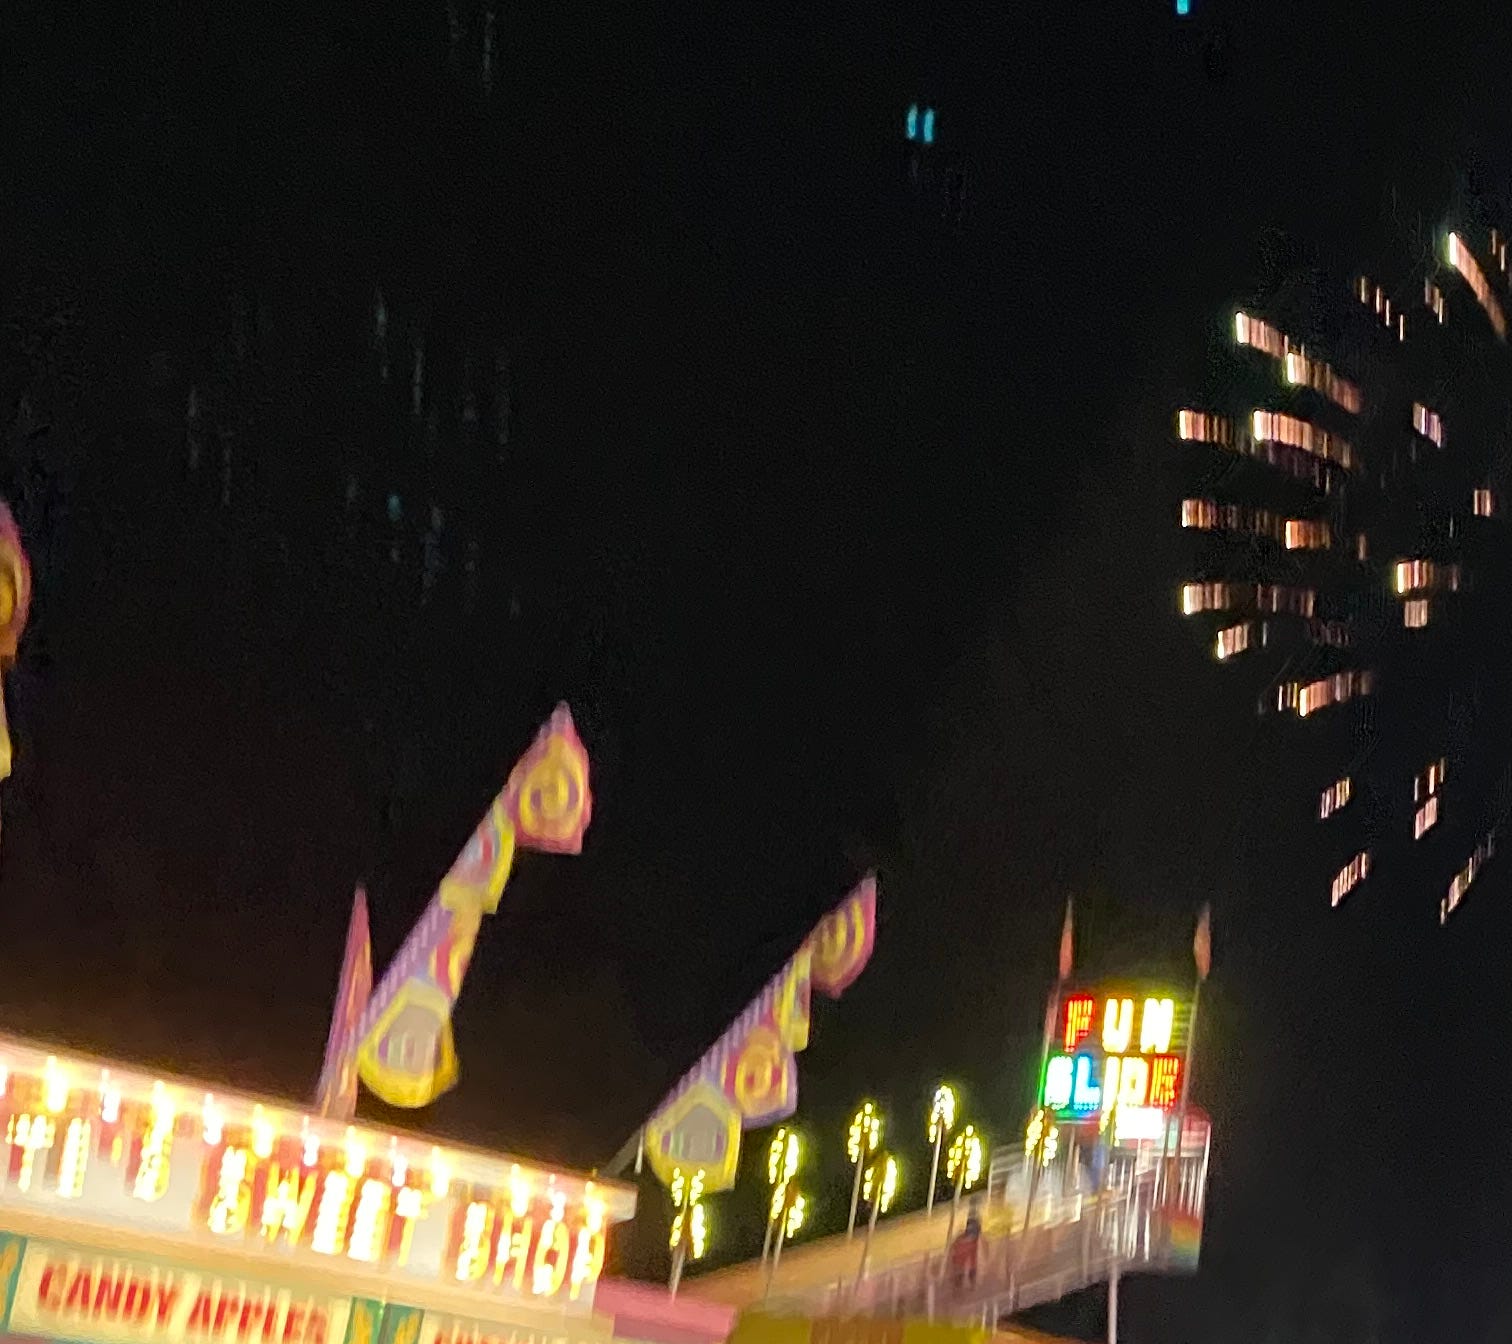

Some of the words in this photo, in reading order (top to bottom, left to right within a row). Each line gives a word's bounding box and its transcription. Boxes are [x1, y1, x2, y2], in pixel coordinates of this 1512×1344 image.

[1064, 996, 1174, 1054] FUN
[1043, 1056, 1179, 1111] SLIDE
[207, 1145, 430, 1267] SWEET
[454, 1201, 607, 1300] SHOP
[38, 1263, 178, 1329] CANDY
